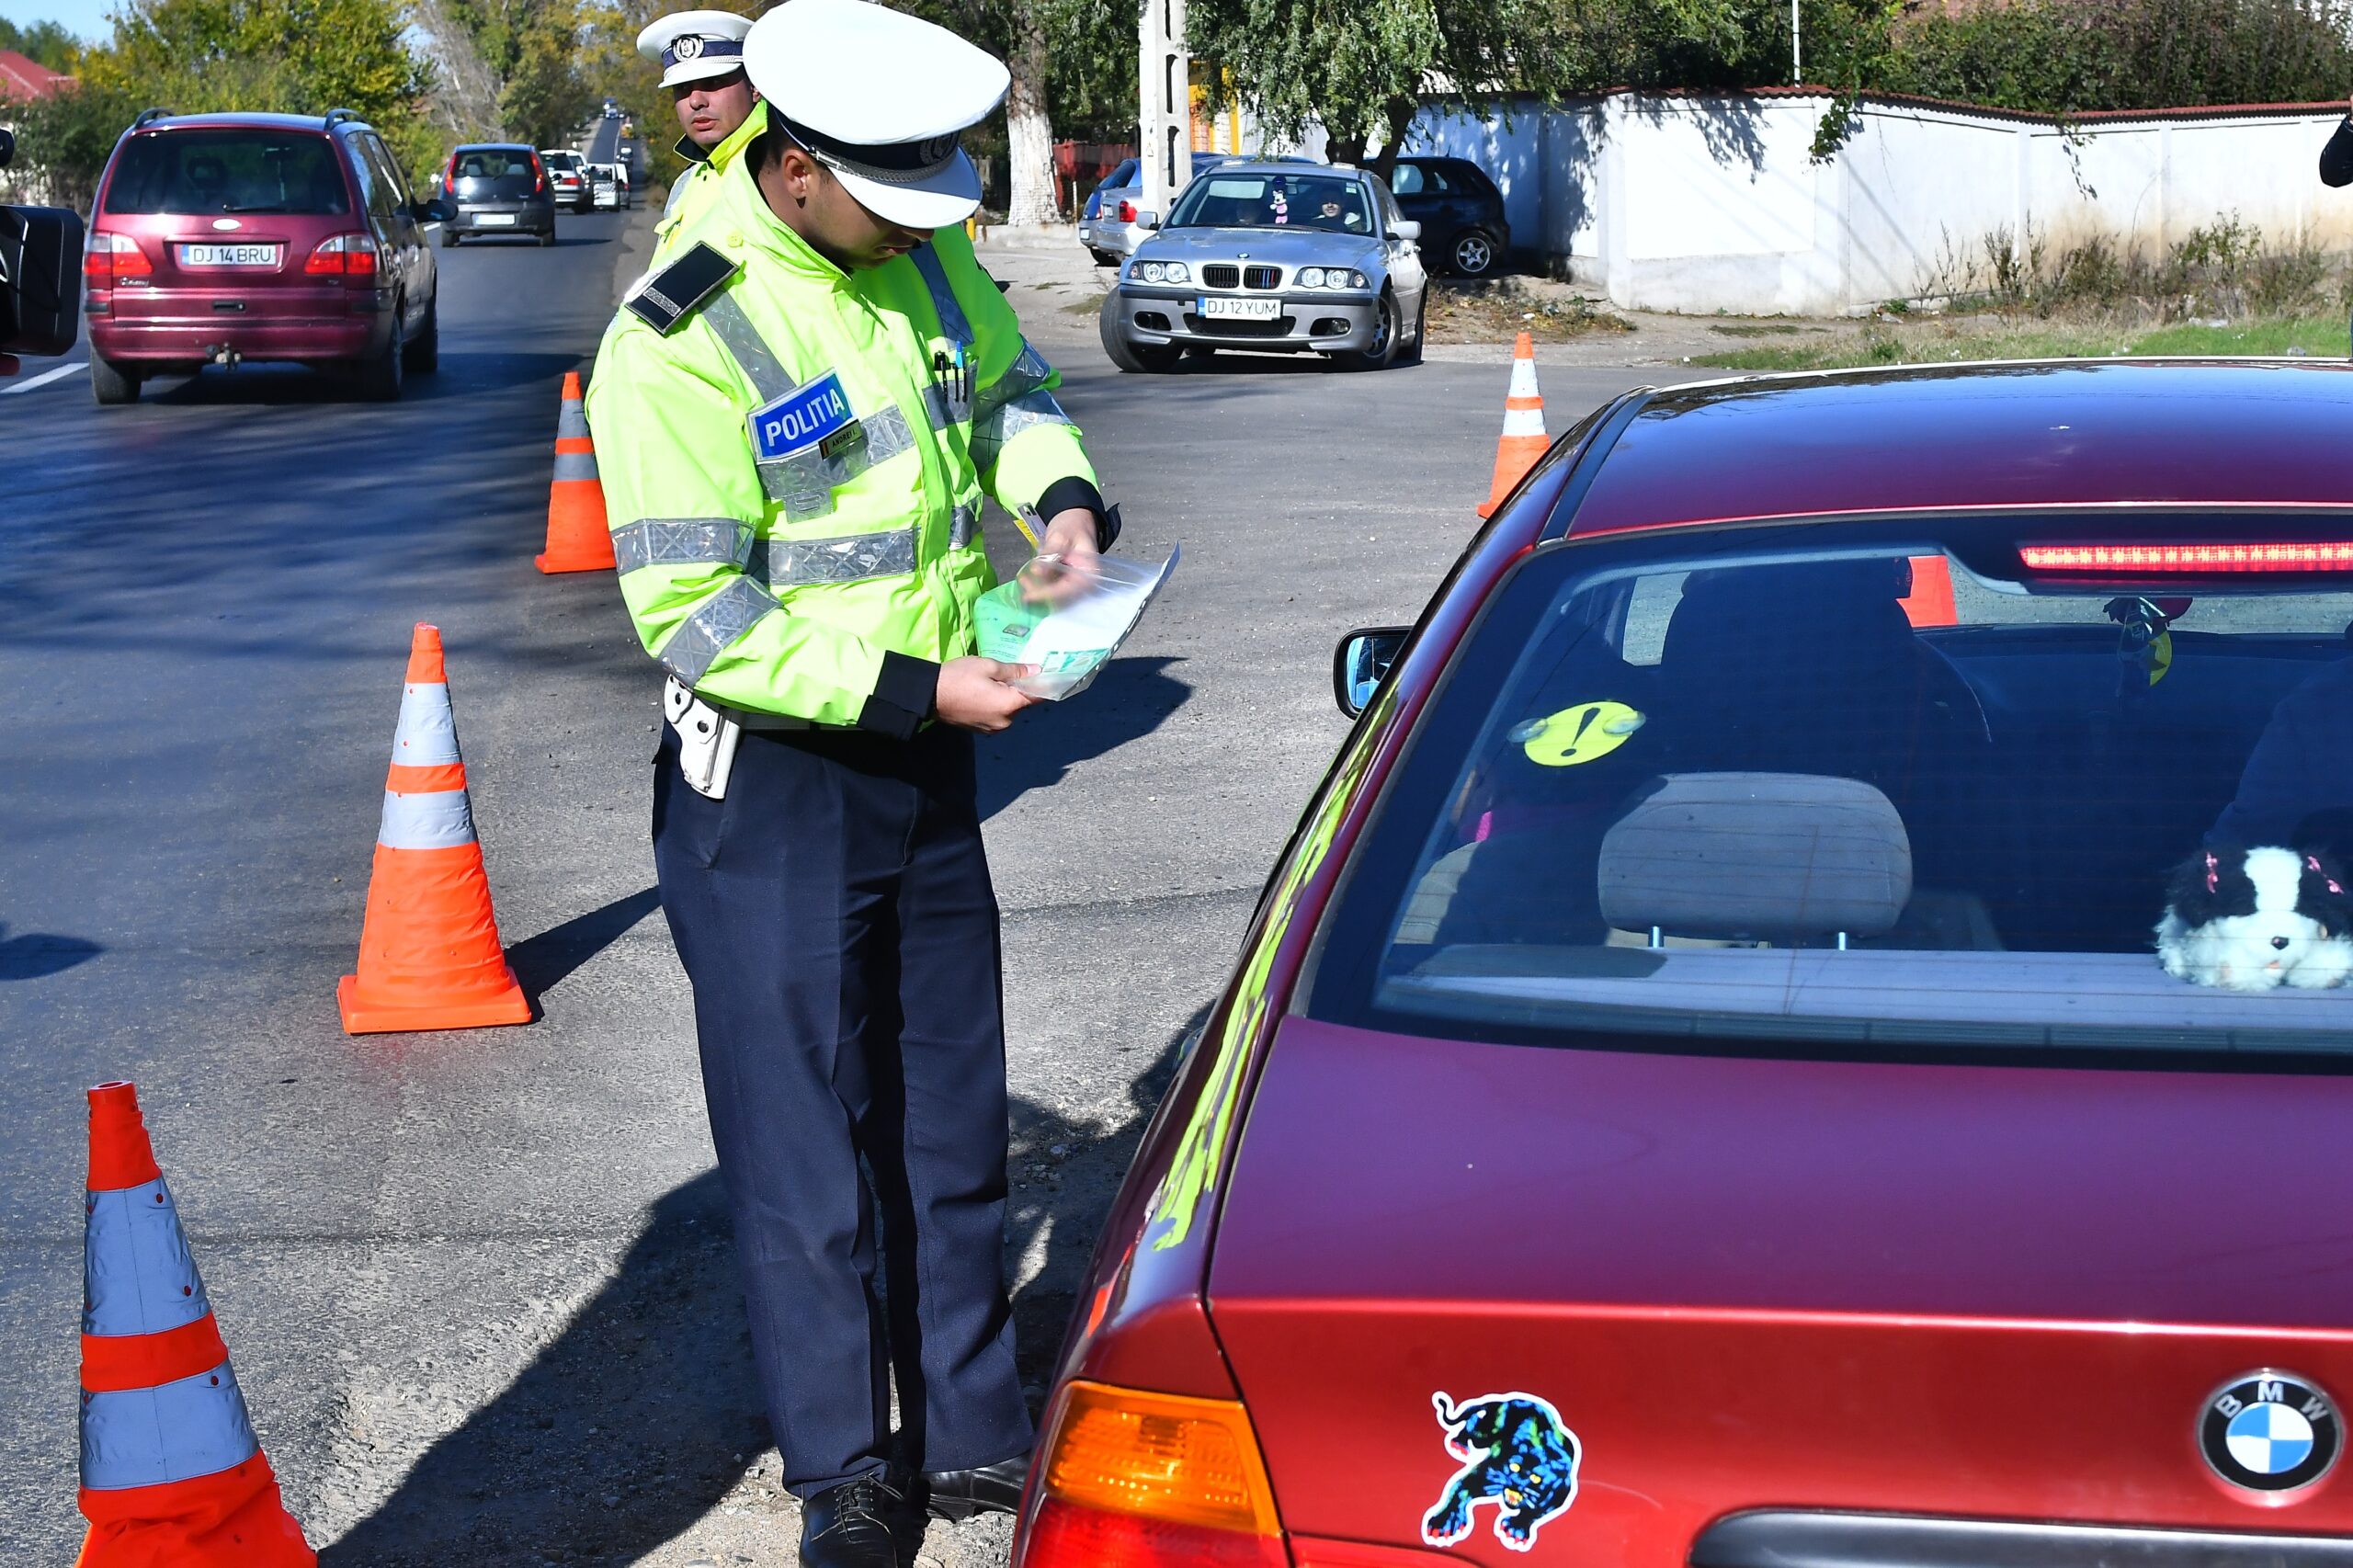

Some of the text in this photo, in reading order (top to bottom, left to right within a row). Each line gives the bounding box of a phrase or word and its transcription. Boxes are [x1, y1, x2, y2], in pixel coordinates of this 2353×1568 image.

[193, 248, 271, 262] DJ 14 BRU
[1208, 301, 1277, 315] DJ 12 YUM
[765, 388, 845, 447] POLITIA
[2214, 1381, 2330, 1421] BMW
